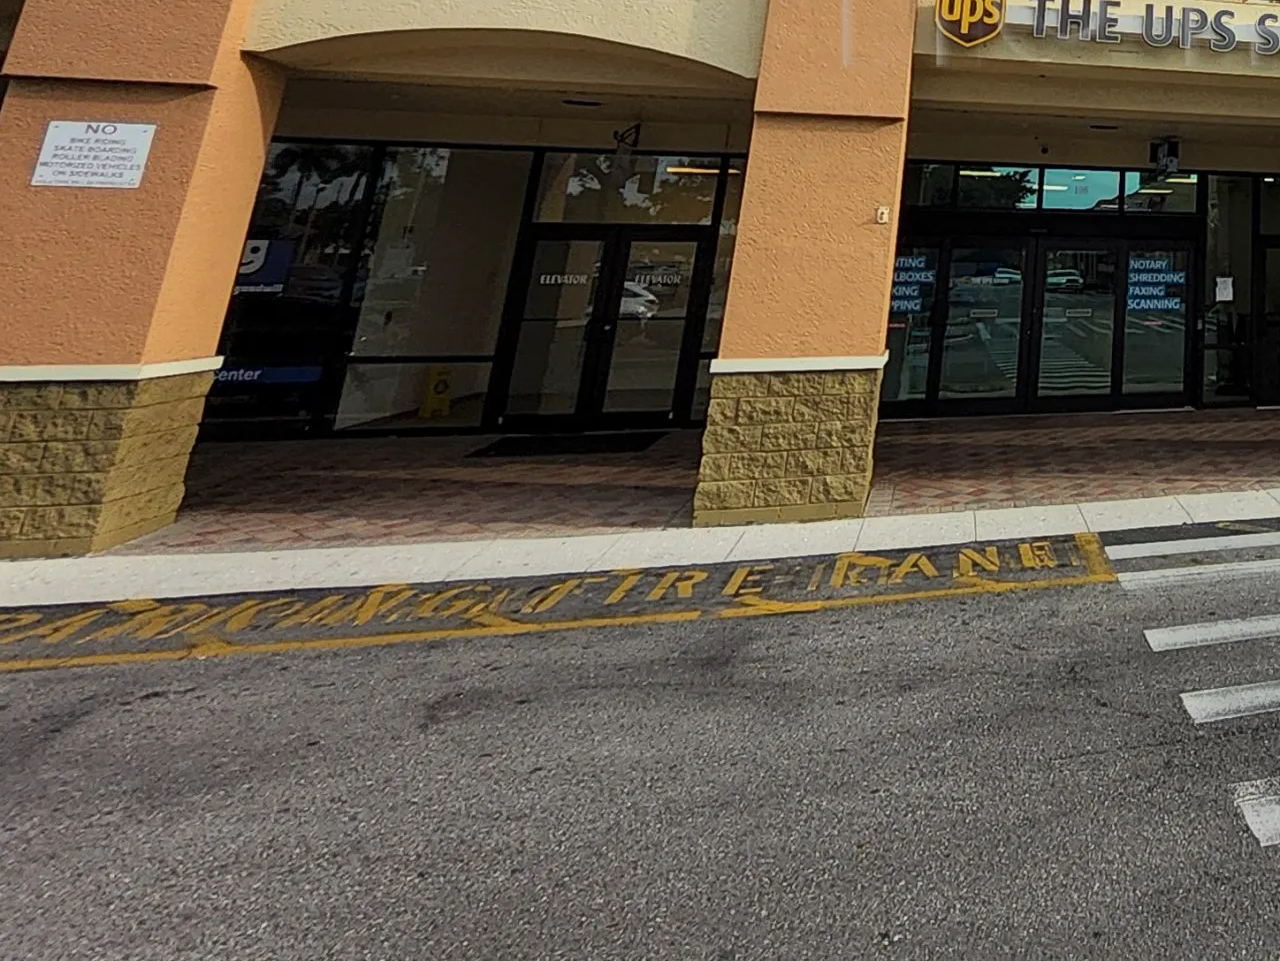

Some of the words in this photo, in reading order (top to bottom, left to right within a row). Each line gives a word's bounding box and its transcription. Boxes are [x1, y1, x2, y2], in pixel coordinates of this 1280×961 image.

[1142, 2, 1237, 53] UPS
[85, 124, 118, 135] NO
[88, 146, 137, 155] BOARDING
[52, 153, 89, 161] ROLLER
[96, 163, 141, 171] VEHICLES
[1130, 259, 1168, 270] NOTARY
[540, 274, 588, 285] ELEVATOR
[1129, 272, 1186, 284] SHREDDING
[1128, 285, 1166, 297] FAXING
[891, 298, 922, 311] PING
[1127, 298, 1181, 310] SCANNING
